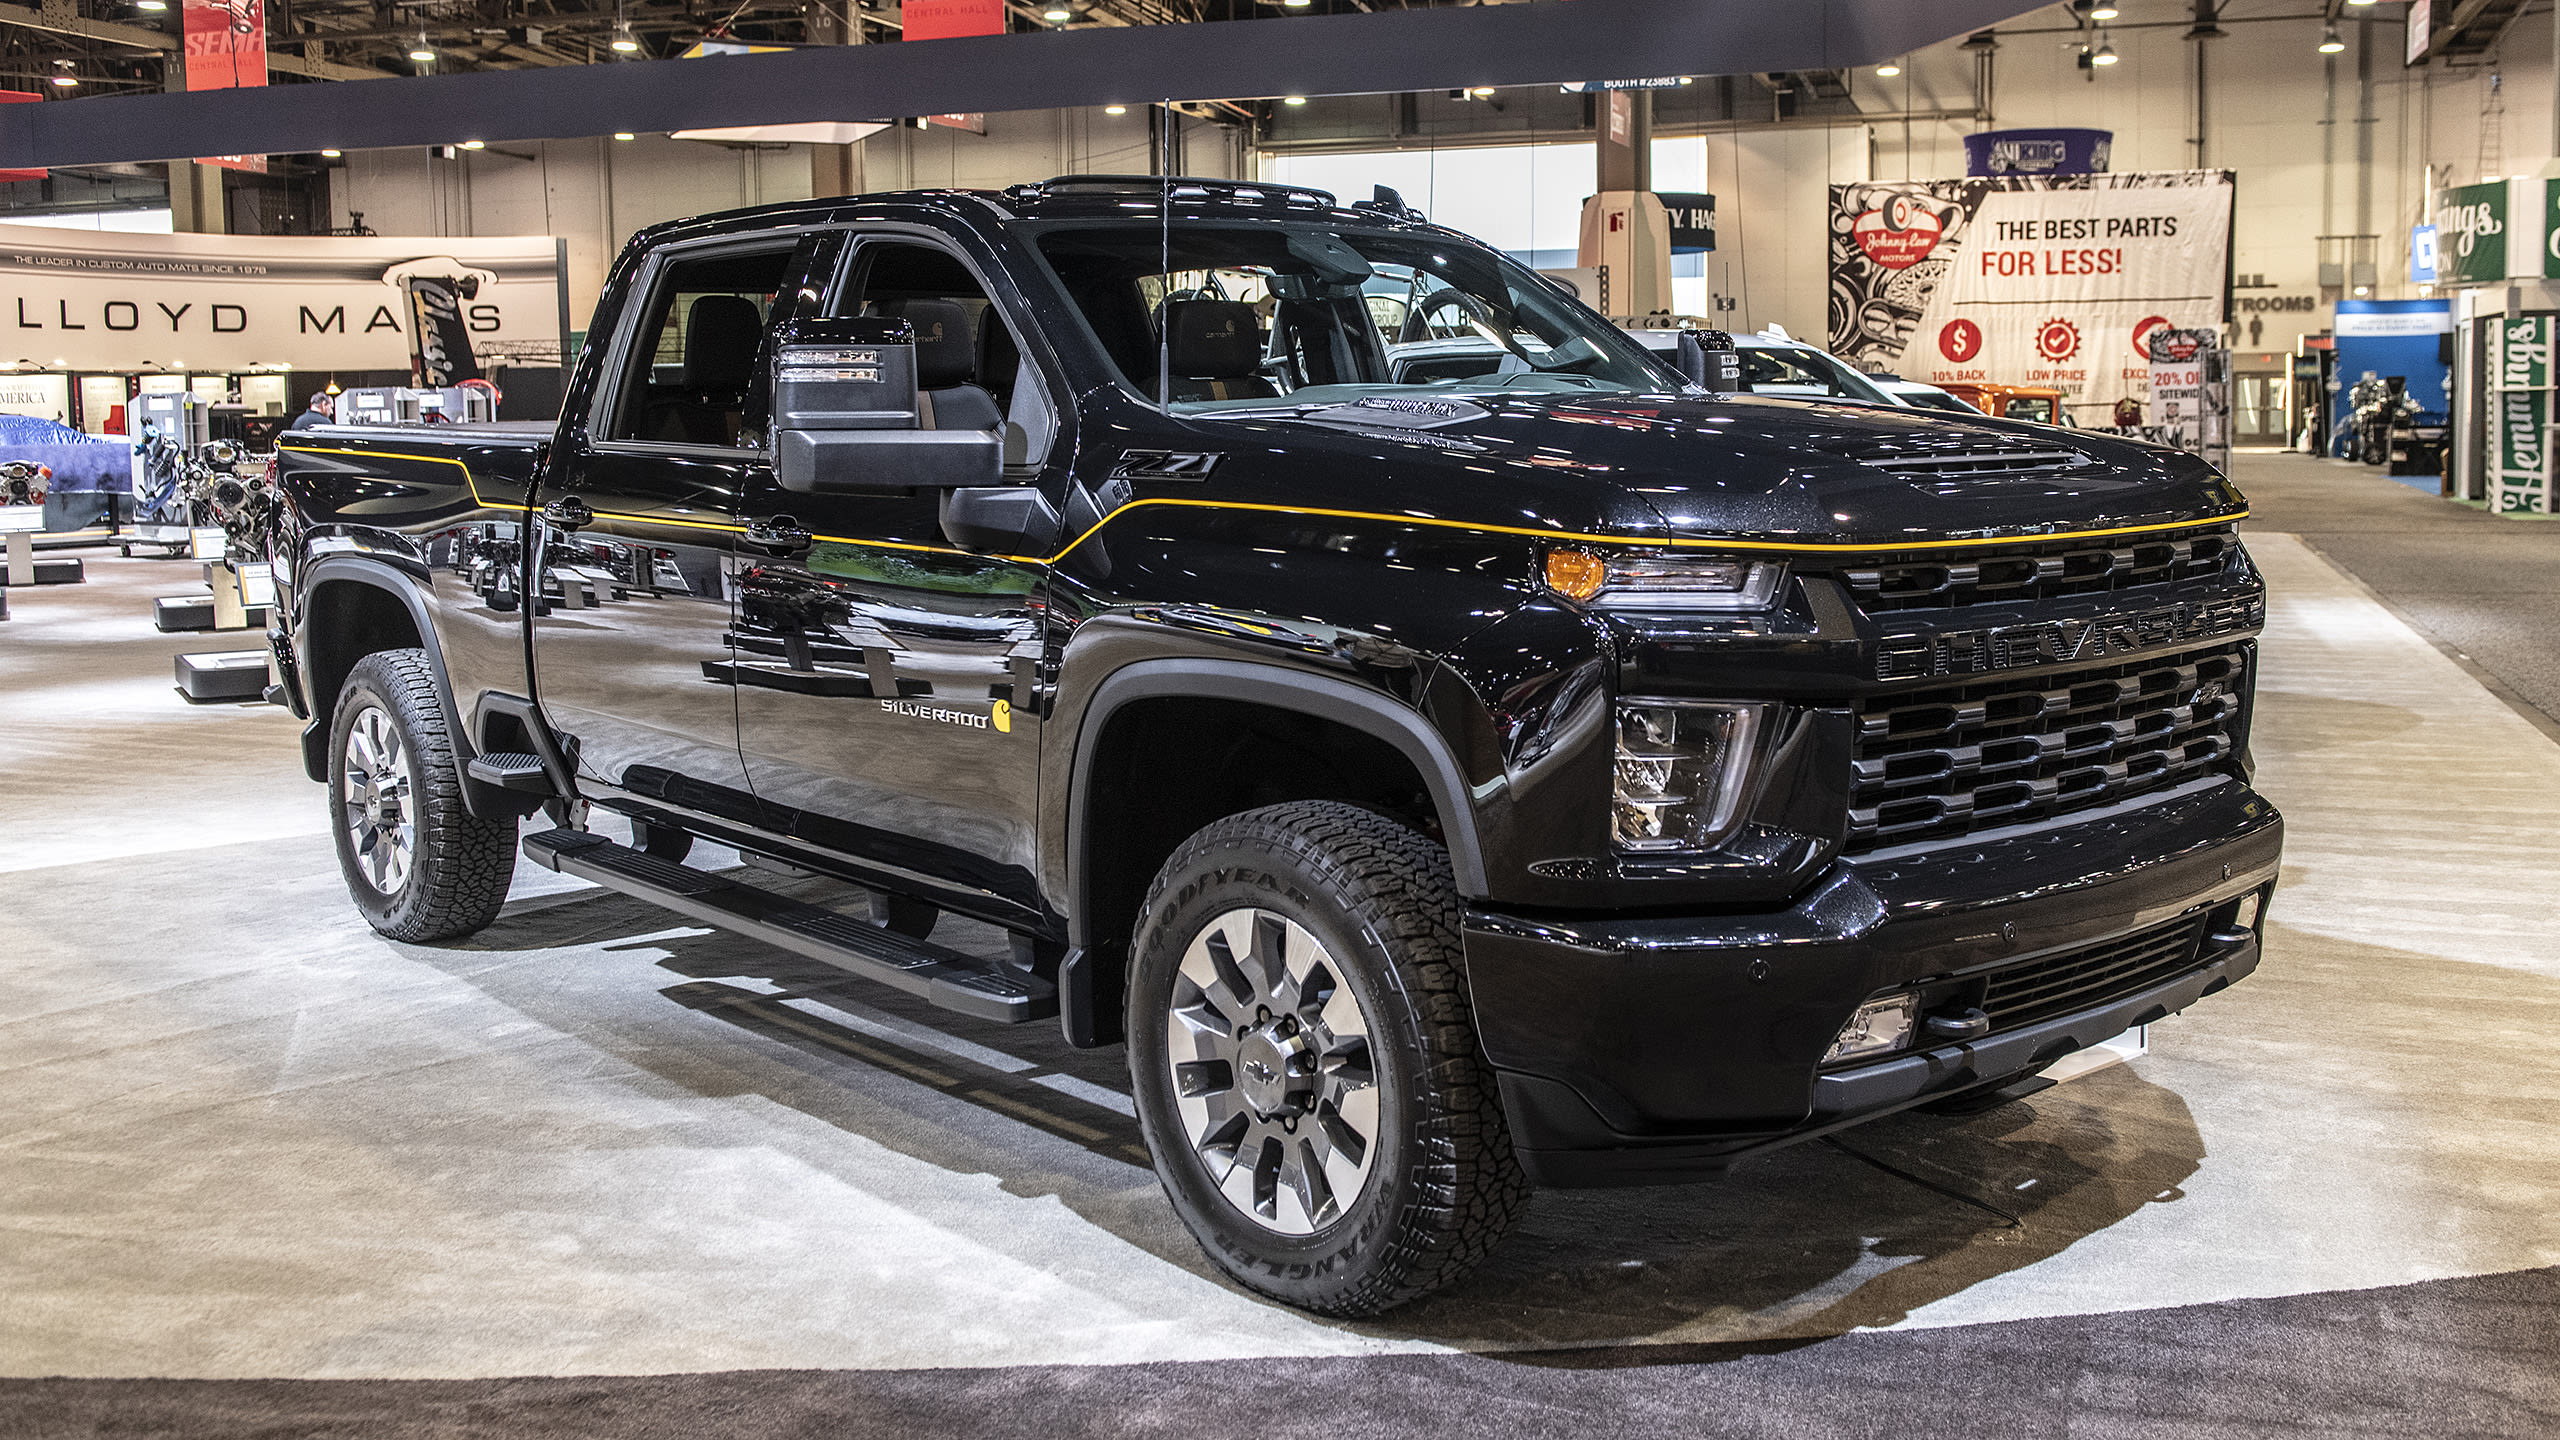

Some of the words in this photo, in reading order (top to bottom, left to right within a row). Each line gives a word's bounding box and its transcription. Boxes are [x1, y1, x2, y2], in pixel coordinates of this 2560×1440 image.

[906, 8, 953, 19] CENTRAL
[960, 5, 988, 16] HALL
[186, 27, 263, 57] SEMA
[1604, 79, 1638, 89] BOOTH
[1996, 221, 2037, 241] THE
[2045, 219, 2100, 240] BEST
[2106, 216, 2178, 238] PARTS
[1866, 232, 1909, 252] Johnny
[14, 255, 34, 265] THE
[36, 257, 74, 267] LEADER
[76, 259, 87, 268] IN
[88, 260, 134, 270] CUSTOM
[136, 262, 166, 272] AUTO
[168, 263, 199, 273] MATS
[202, 264, 234, 274] SINCE
[1879, 254, 1916, 263] MOTORS
[1981, 251, 2035, 277] FOR
[2045, 248, 2122, 276] LESS!
[17, 297, 248, 333] LLOYD
[299, 305, 501, 334] MAS
[411, 280, 457, 387] Classic
[1932, 370, 1954, 382] 10%
[1956, 370, 1986, 381] BACK
[2026, 370, 2051, 381] LOW
[2054, 369, 2087, 381] PRICE
[2155, 371, 2182, 386] 20%
[1109, 449, 1225, 482] Z71
[1877, 590, 2265, 681] CHEVROLET
[881, 699, 989, 729] SILVERADO
